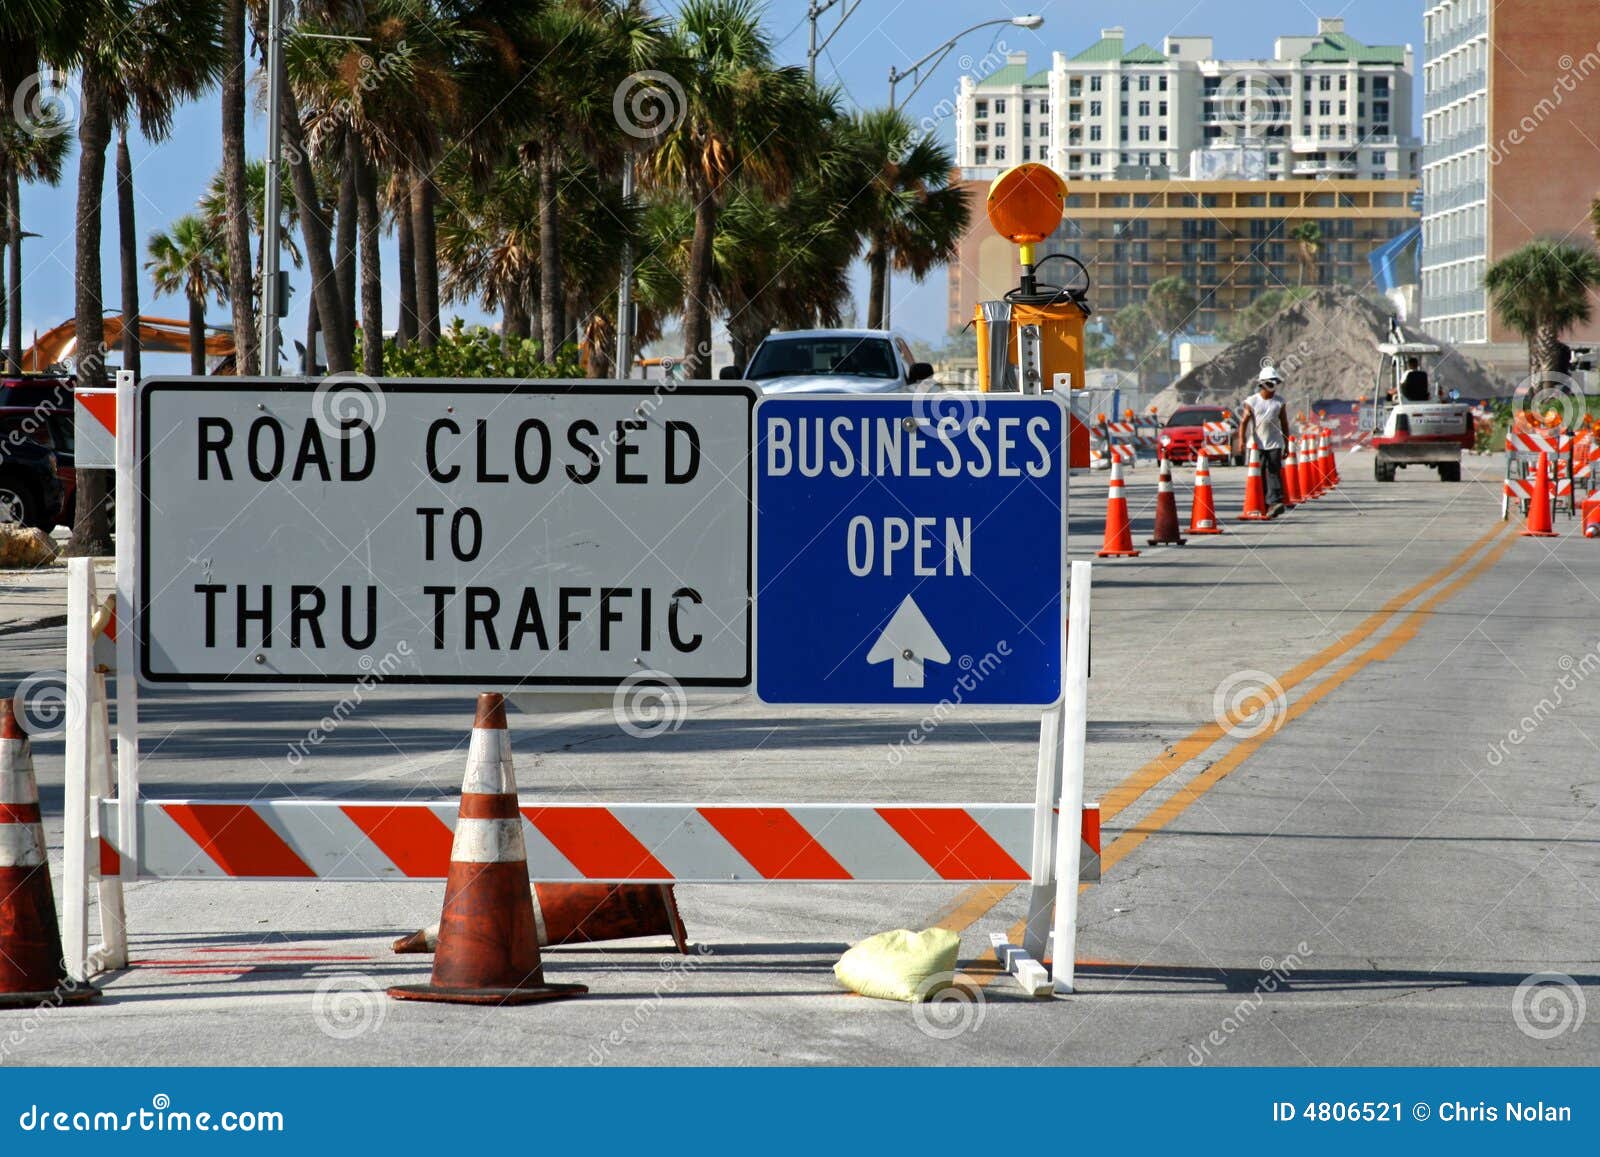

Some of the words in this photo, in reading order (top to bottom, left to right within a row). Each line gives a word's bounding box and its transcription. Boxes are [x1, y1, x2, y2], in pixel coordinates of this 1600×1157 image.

[198, 415, 376, 483] ROAD
[425, 417, 701, 485] CLOSED
[766, 415, 1052, 479] BUSINESSES
[416, 506, 483, 563] TO
[847, 515, 972, 578] OPEN
[194, 583, 377, 651] THRU
[423, 585, 704, 653] TRAFFIC
